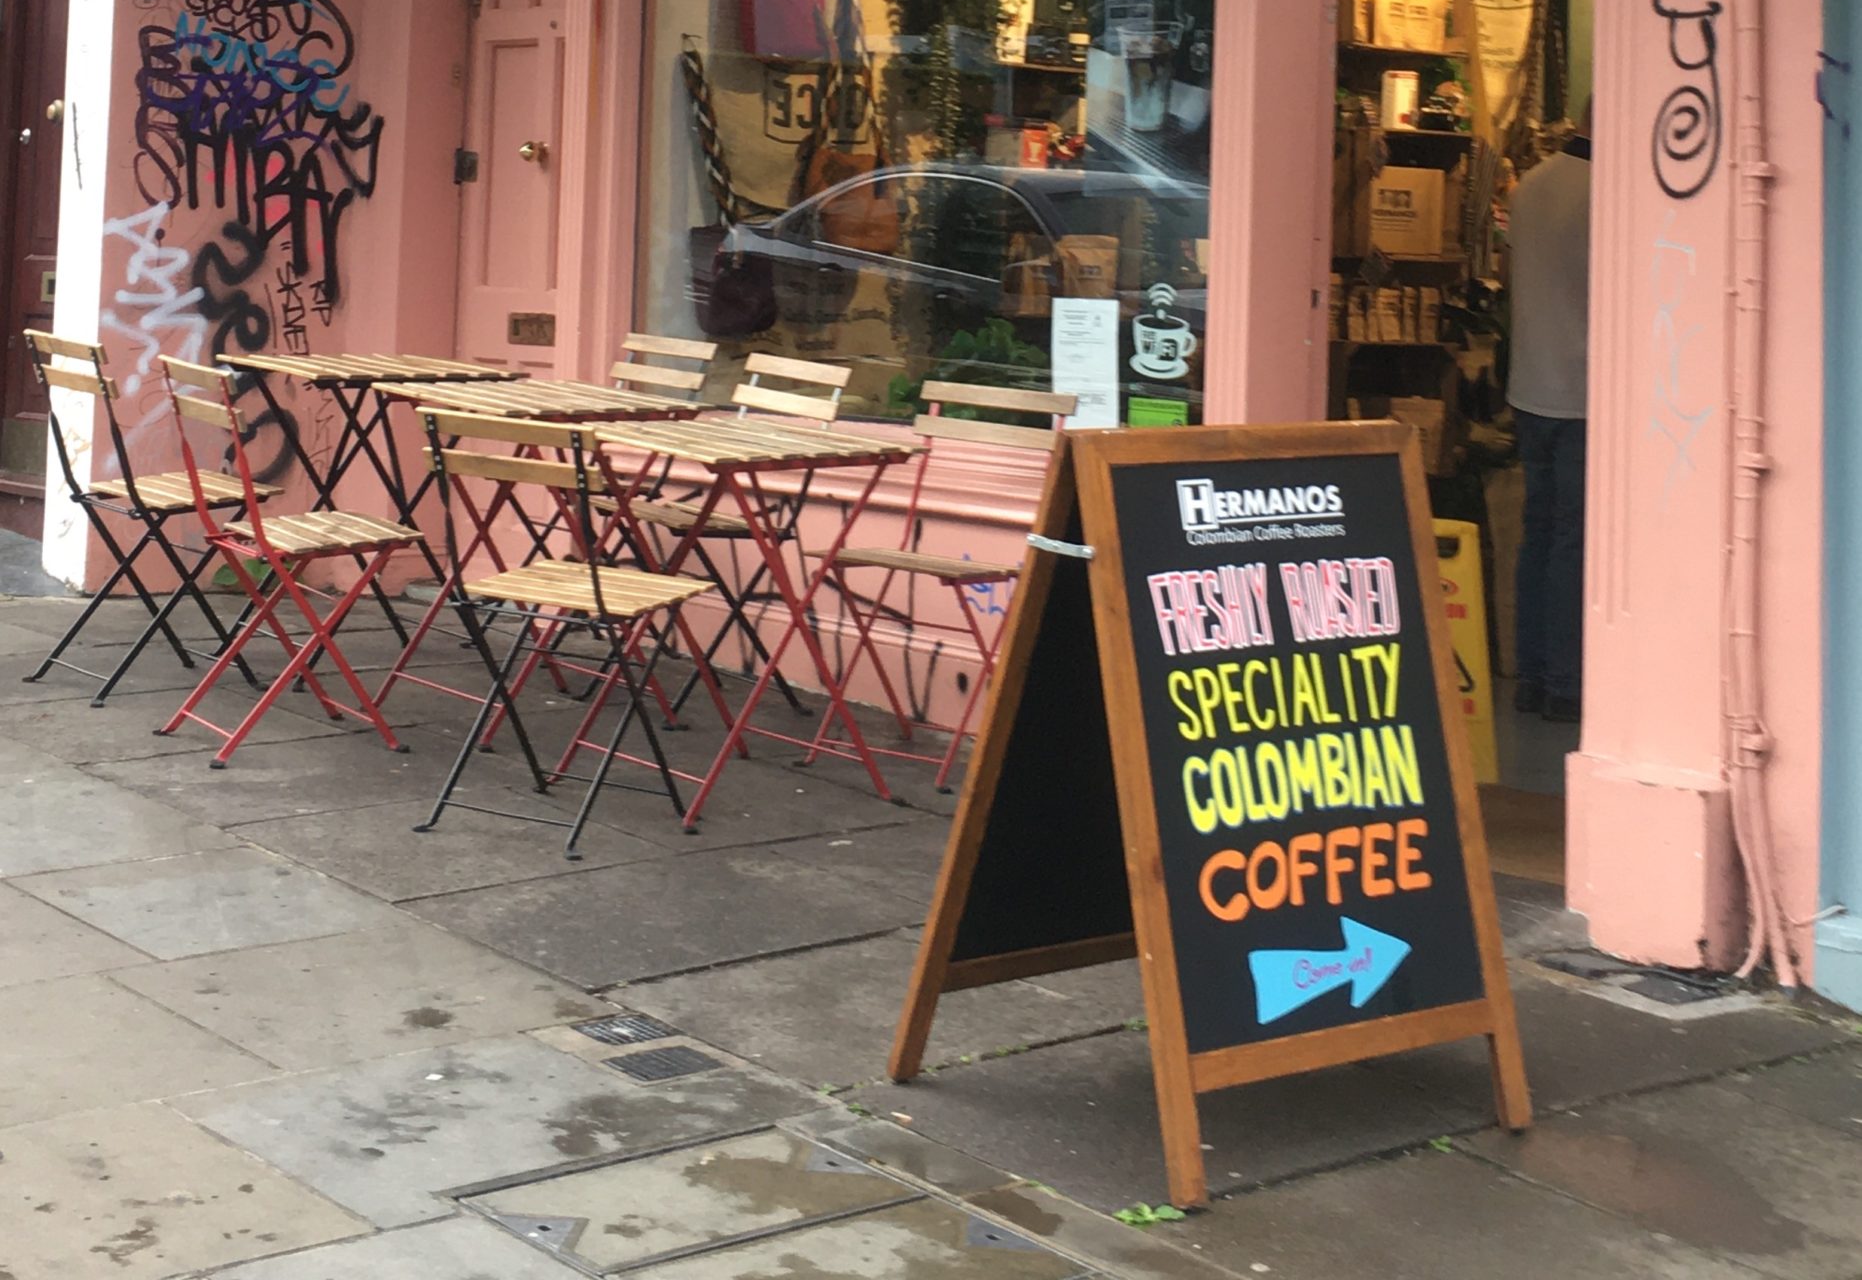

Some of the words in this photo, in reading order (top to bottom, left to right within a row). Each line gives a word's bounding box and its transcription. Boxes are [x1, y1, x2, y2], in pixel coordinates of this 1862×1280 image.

[1177, 479, 1344, 529] HERMANOS
[1186, 527, 1254, 546] Colombian
[1253, 523, 1294, 541] Coffee
[1148, 563, 1274, 655] FRESHLY
[1280, 557, 1401, 642] ROASTED
[1167, 643, 1400, 740] SPECIALITY
[1182, 725, 1424, 834] COLOMBIAN
[1199, 819, 1432, 921] COFFEE
